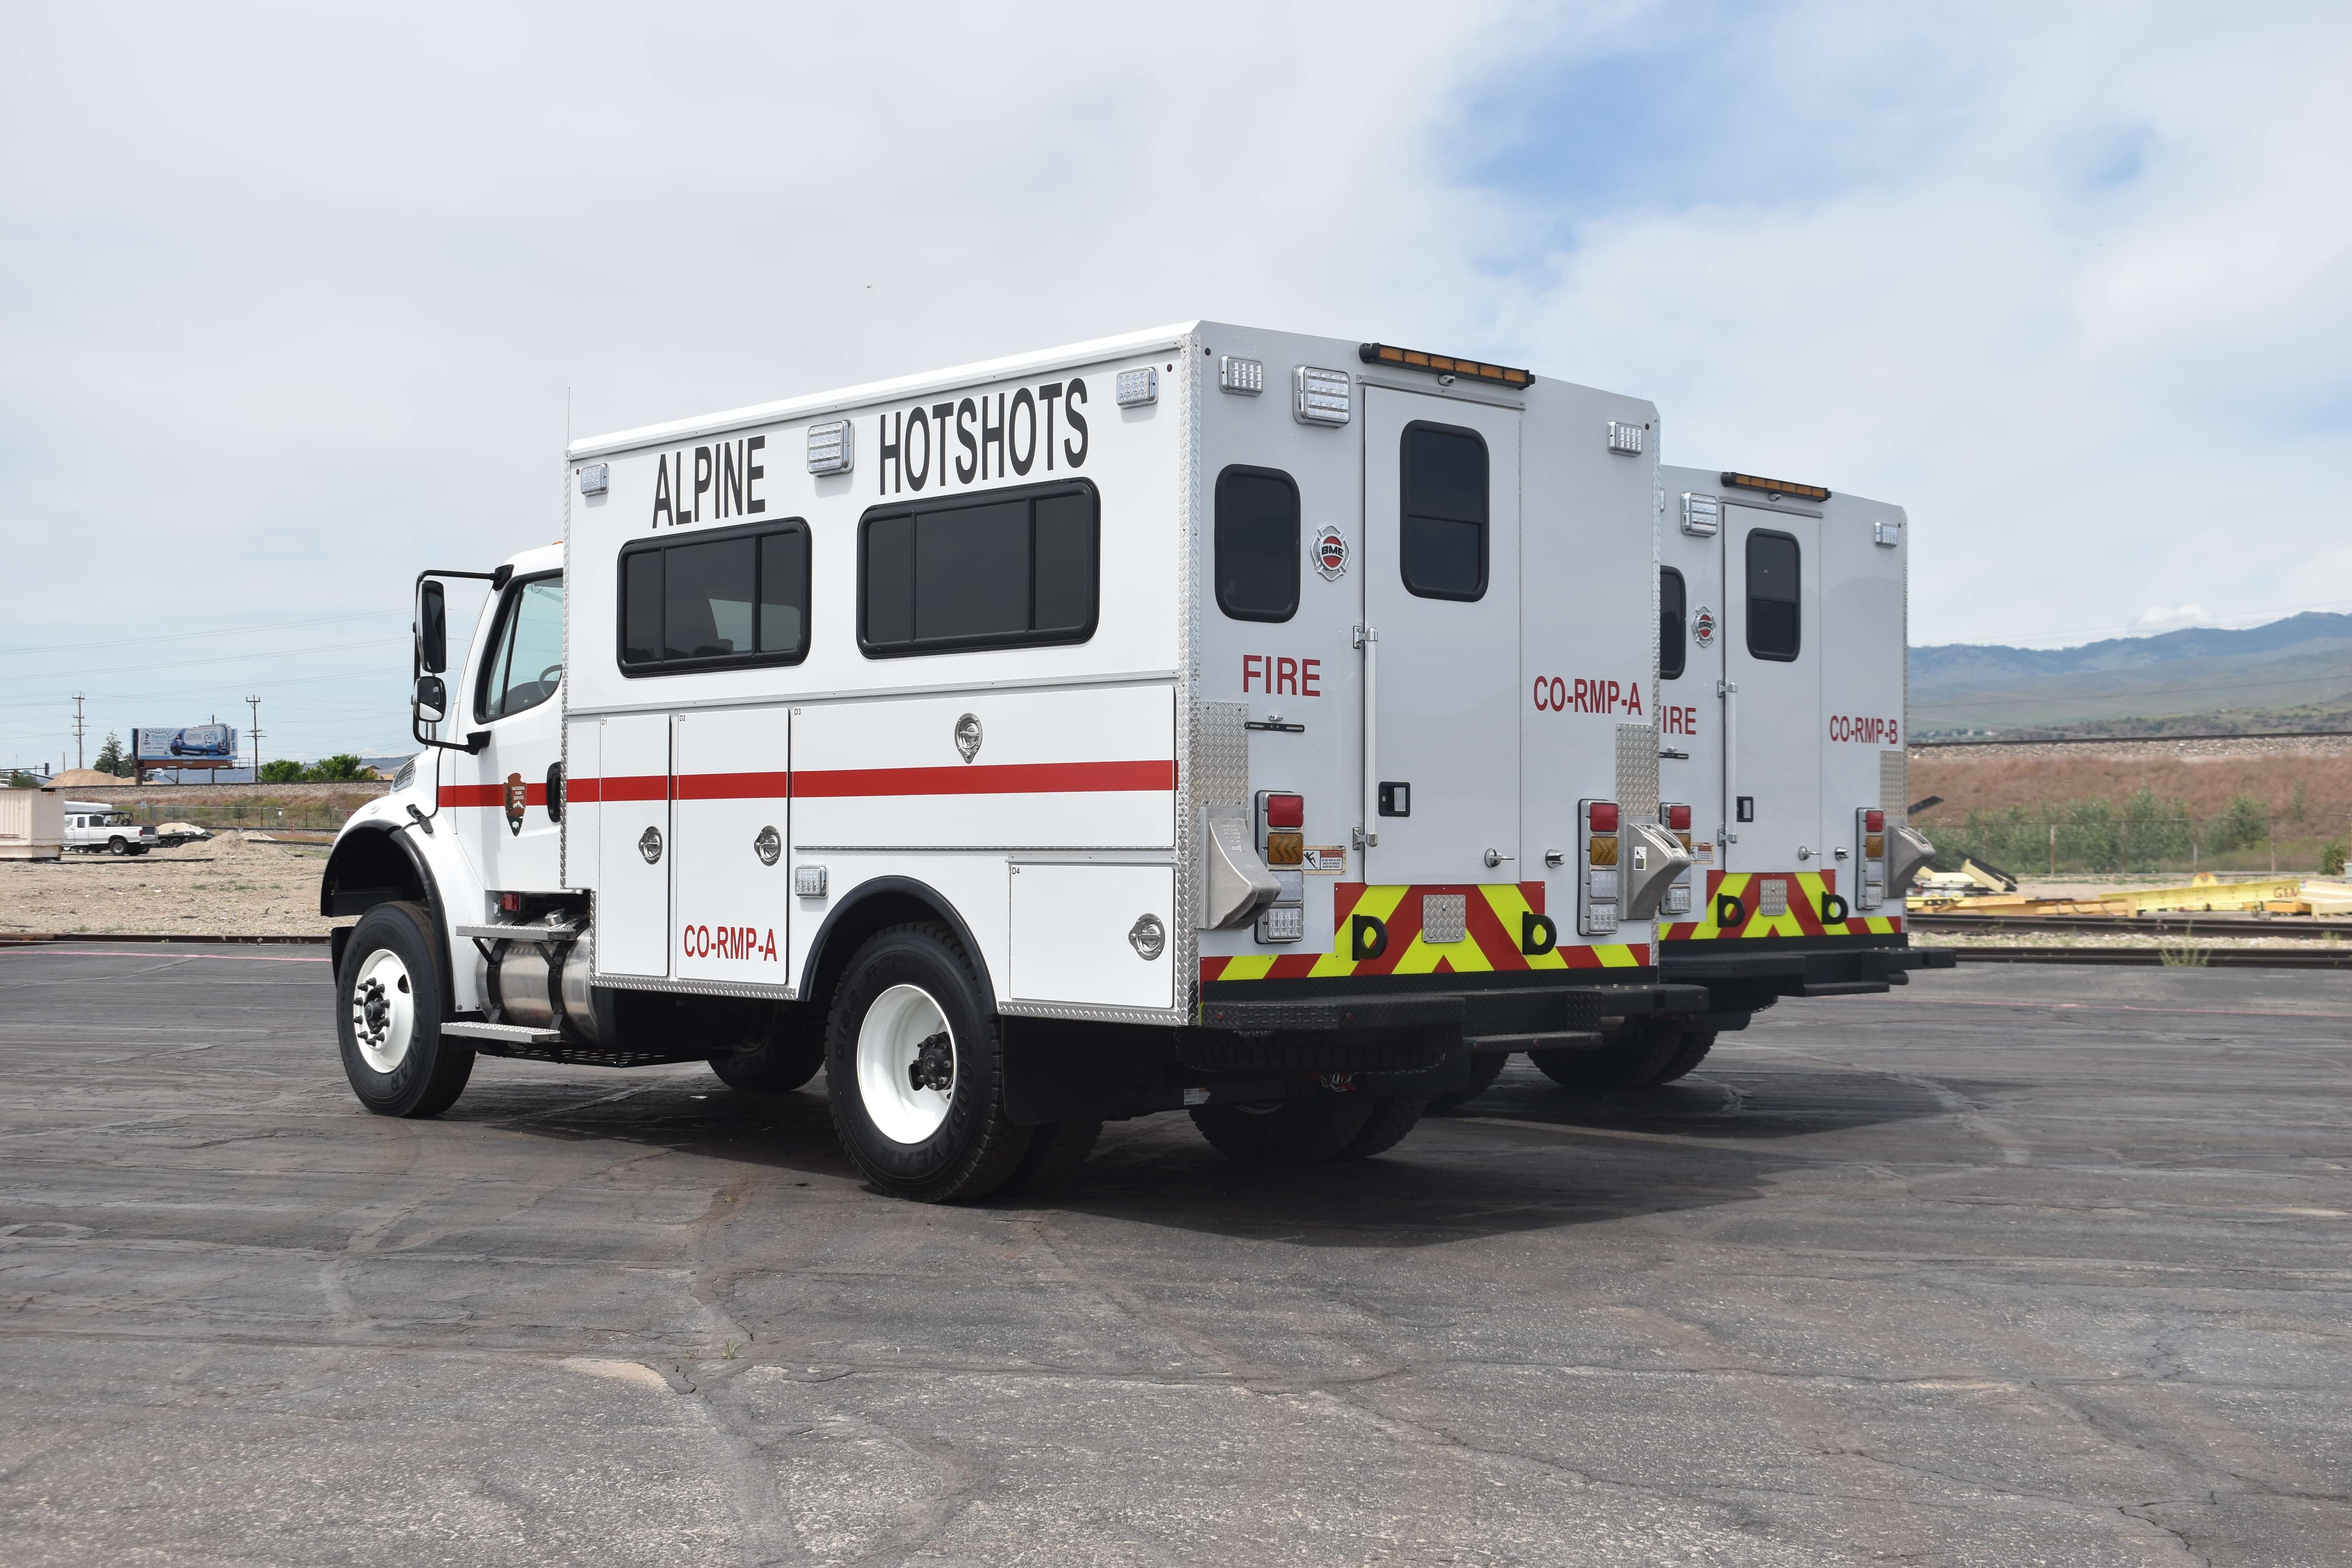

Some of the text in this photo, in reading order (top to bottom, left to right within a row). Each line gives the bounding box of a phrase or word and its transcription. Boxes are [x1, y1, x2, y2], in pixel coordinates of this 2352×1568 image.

[652, 378, 1088, 529] ALPINE HOTSHOTS
[1321, 545, 1344, 558] BME
[1243, 655, 1320, 697] FIRE
[1534, 676, 1642, 715] CO-RMP-A
[1659, 705, 1696, 735] IRE
[1829, 715, 1898, 744] CO-RMP-B
[684, 925, 777, 962] CO-RMP-A
